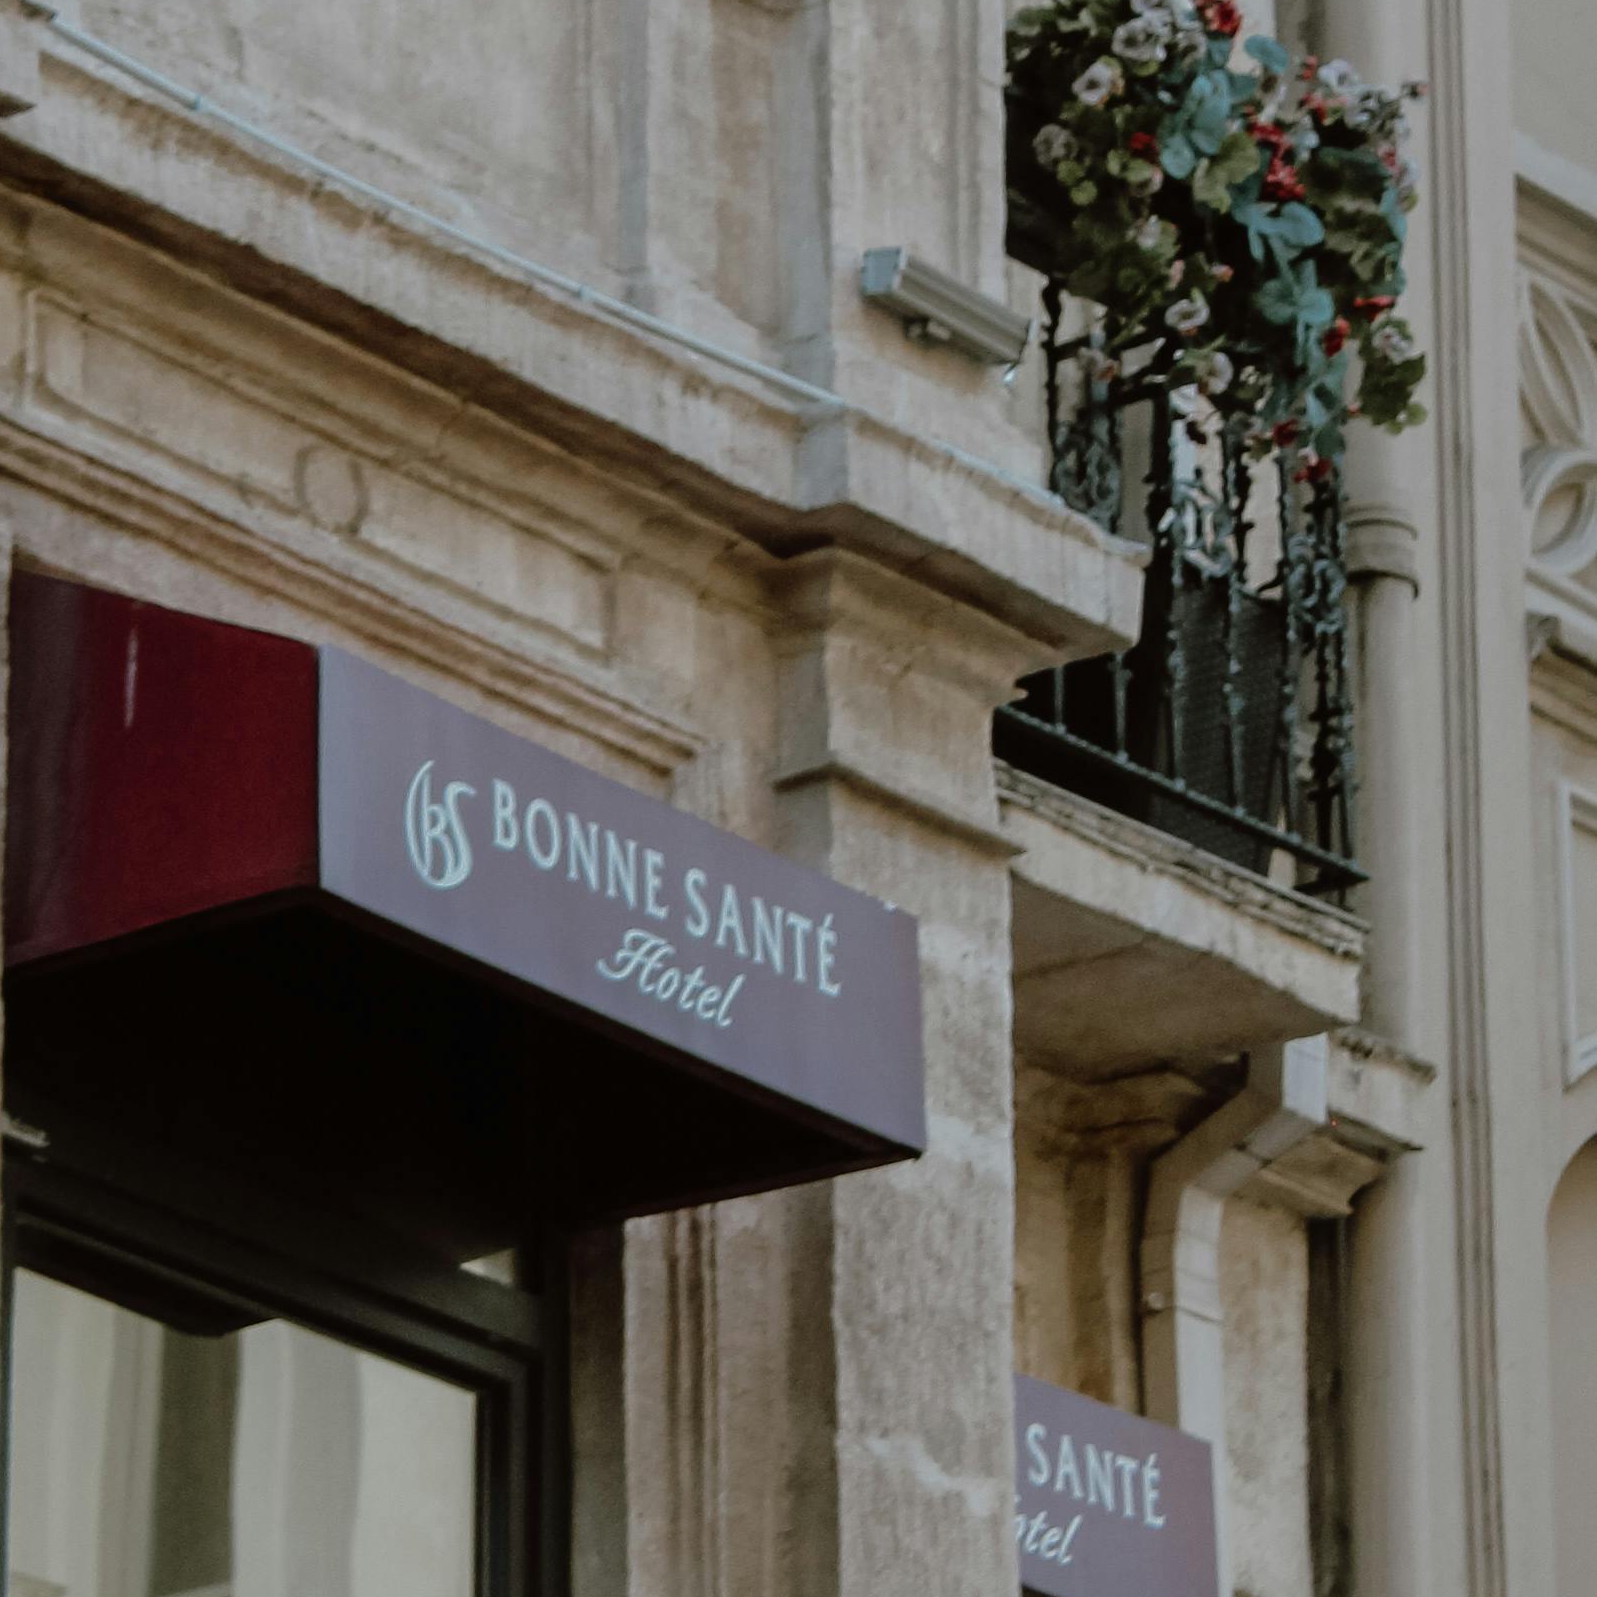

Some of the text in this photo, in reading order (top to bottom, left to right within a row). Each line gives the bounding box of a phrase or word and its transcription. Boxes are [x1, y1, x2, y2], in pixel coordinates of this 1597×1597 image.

[490, 777, 668, 919] BONNE
[683, 867, 842, 997] SANTÉ
[596, 927, 747, 1029] Hotel
[1025, 1422, 1167, 1531] SANTÉ
